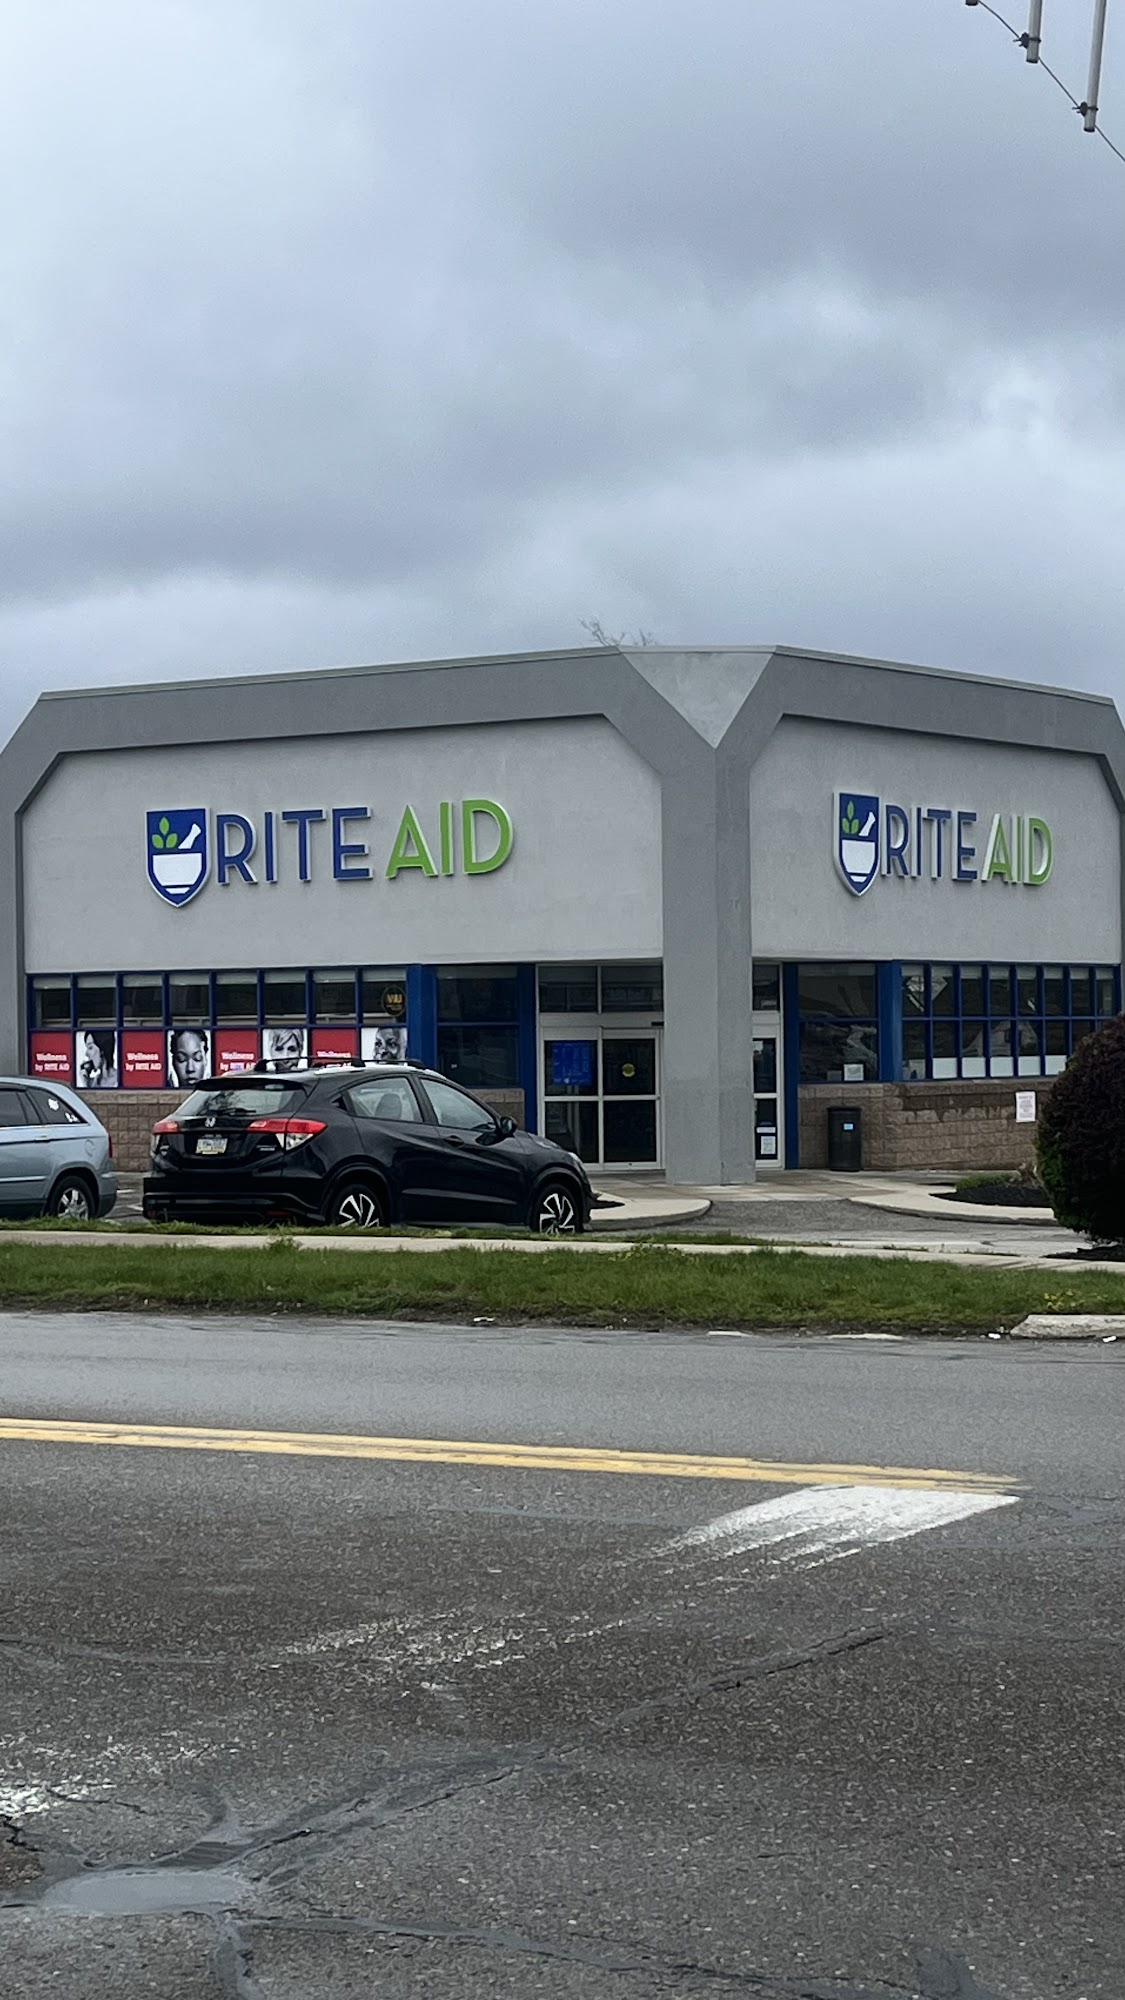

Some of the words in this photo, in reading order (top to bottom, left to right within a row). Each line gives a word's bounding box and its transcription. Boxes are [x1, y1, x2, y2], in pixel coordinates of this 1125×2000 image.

[215, 806, 374, 885] RITE
[385, 798, 514, 880] AID
[880, 804, 978, 881] RITE
[981, 812, 1054, 886] AID
[125, 1062, 134, 1072] by
[149, 1062, 162, 1070] AID
[126, 1052, 159, 1061] Wellness
